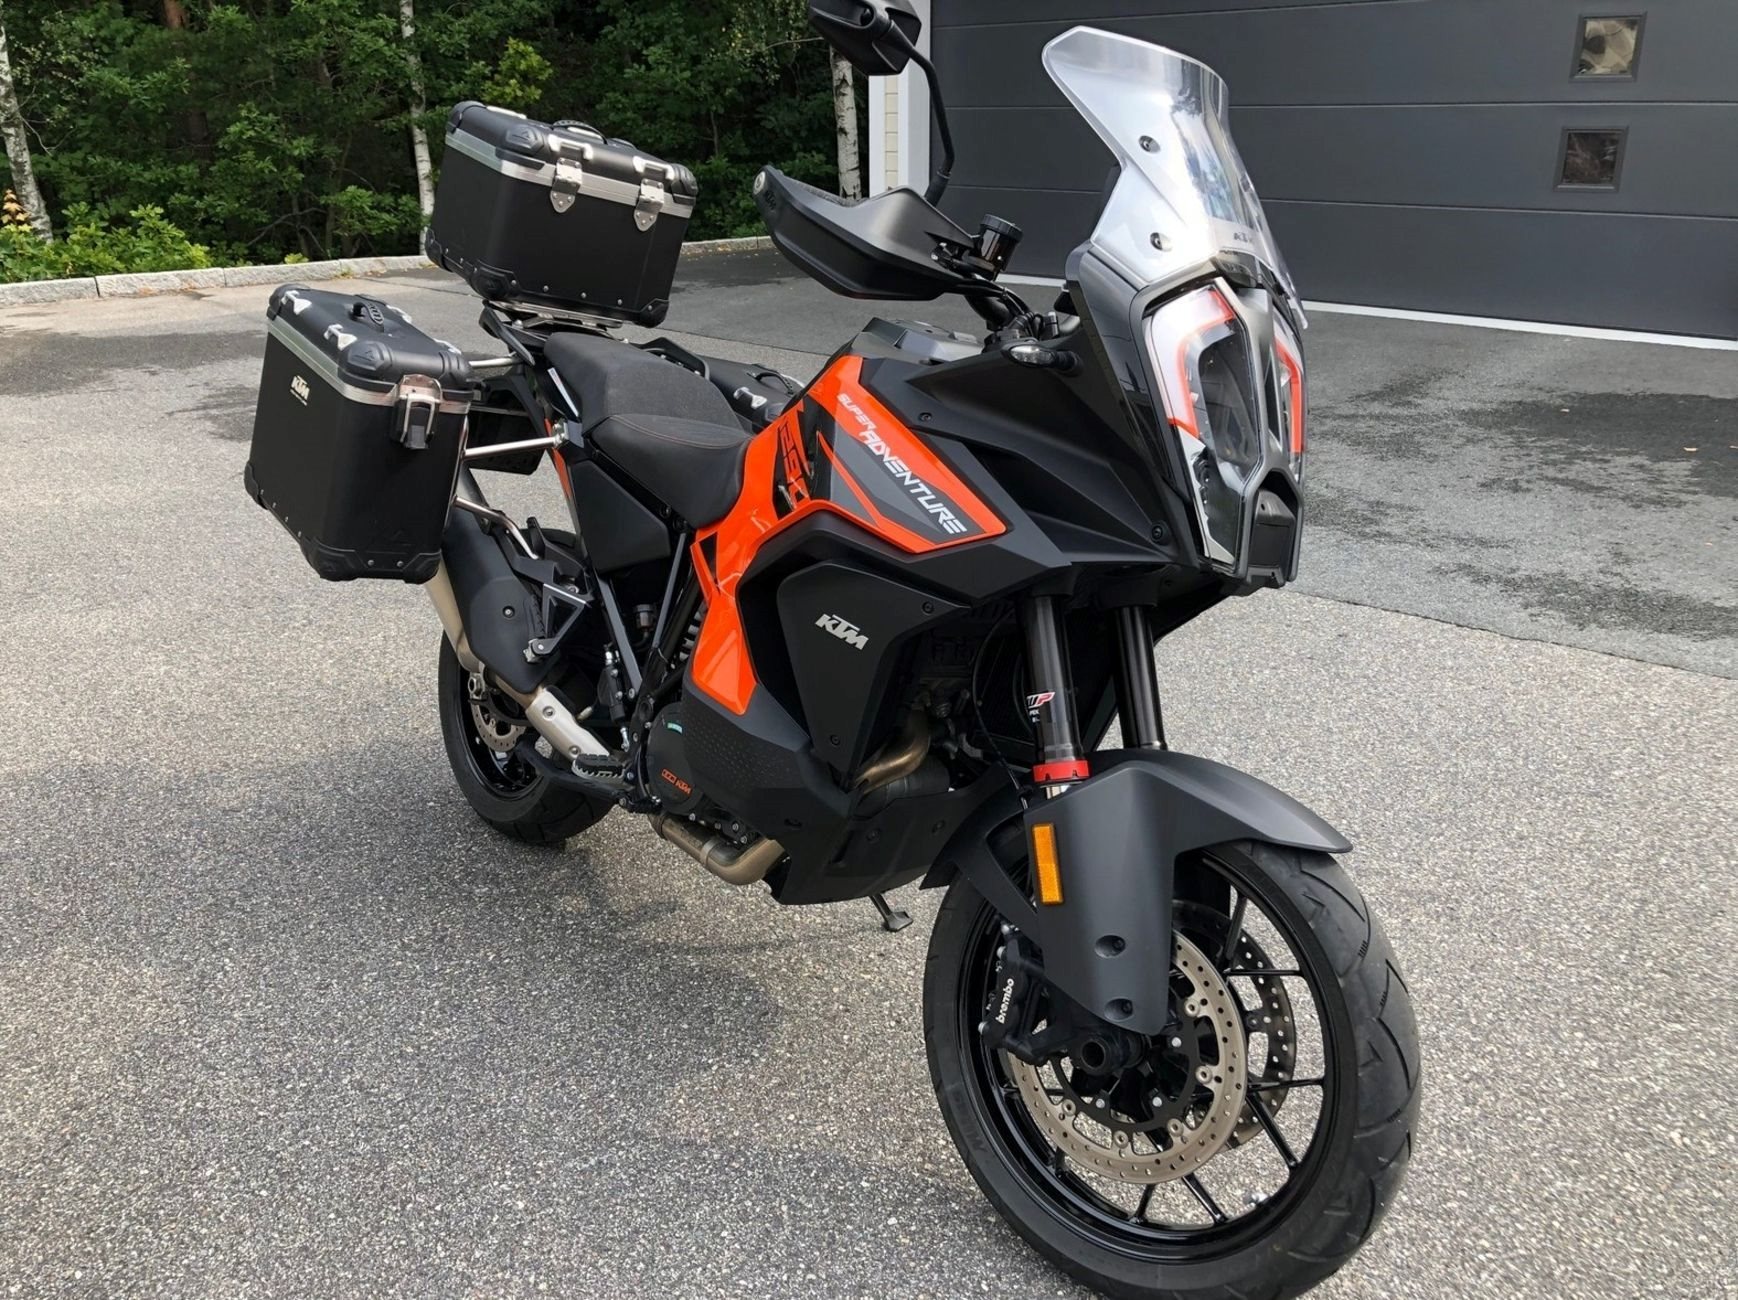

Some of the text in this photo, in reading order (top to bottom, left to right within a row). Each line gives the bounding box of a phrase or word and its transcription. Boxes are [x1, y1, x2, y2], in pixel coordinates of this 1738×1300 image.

[290, 375, 311, 400] KTM
[837, 393, 968, 534] SUPER ADVENTURE
[815, 613, 869, 650] KTM
[995, 978, 1015, 1024] brembo
